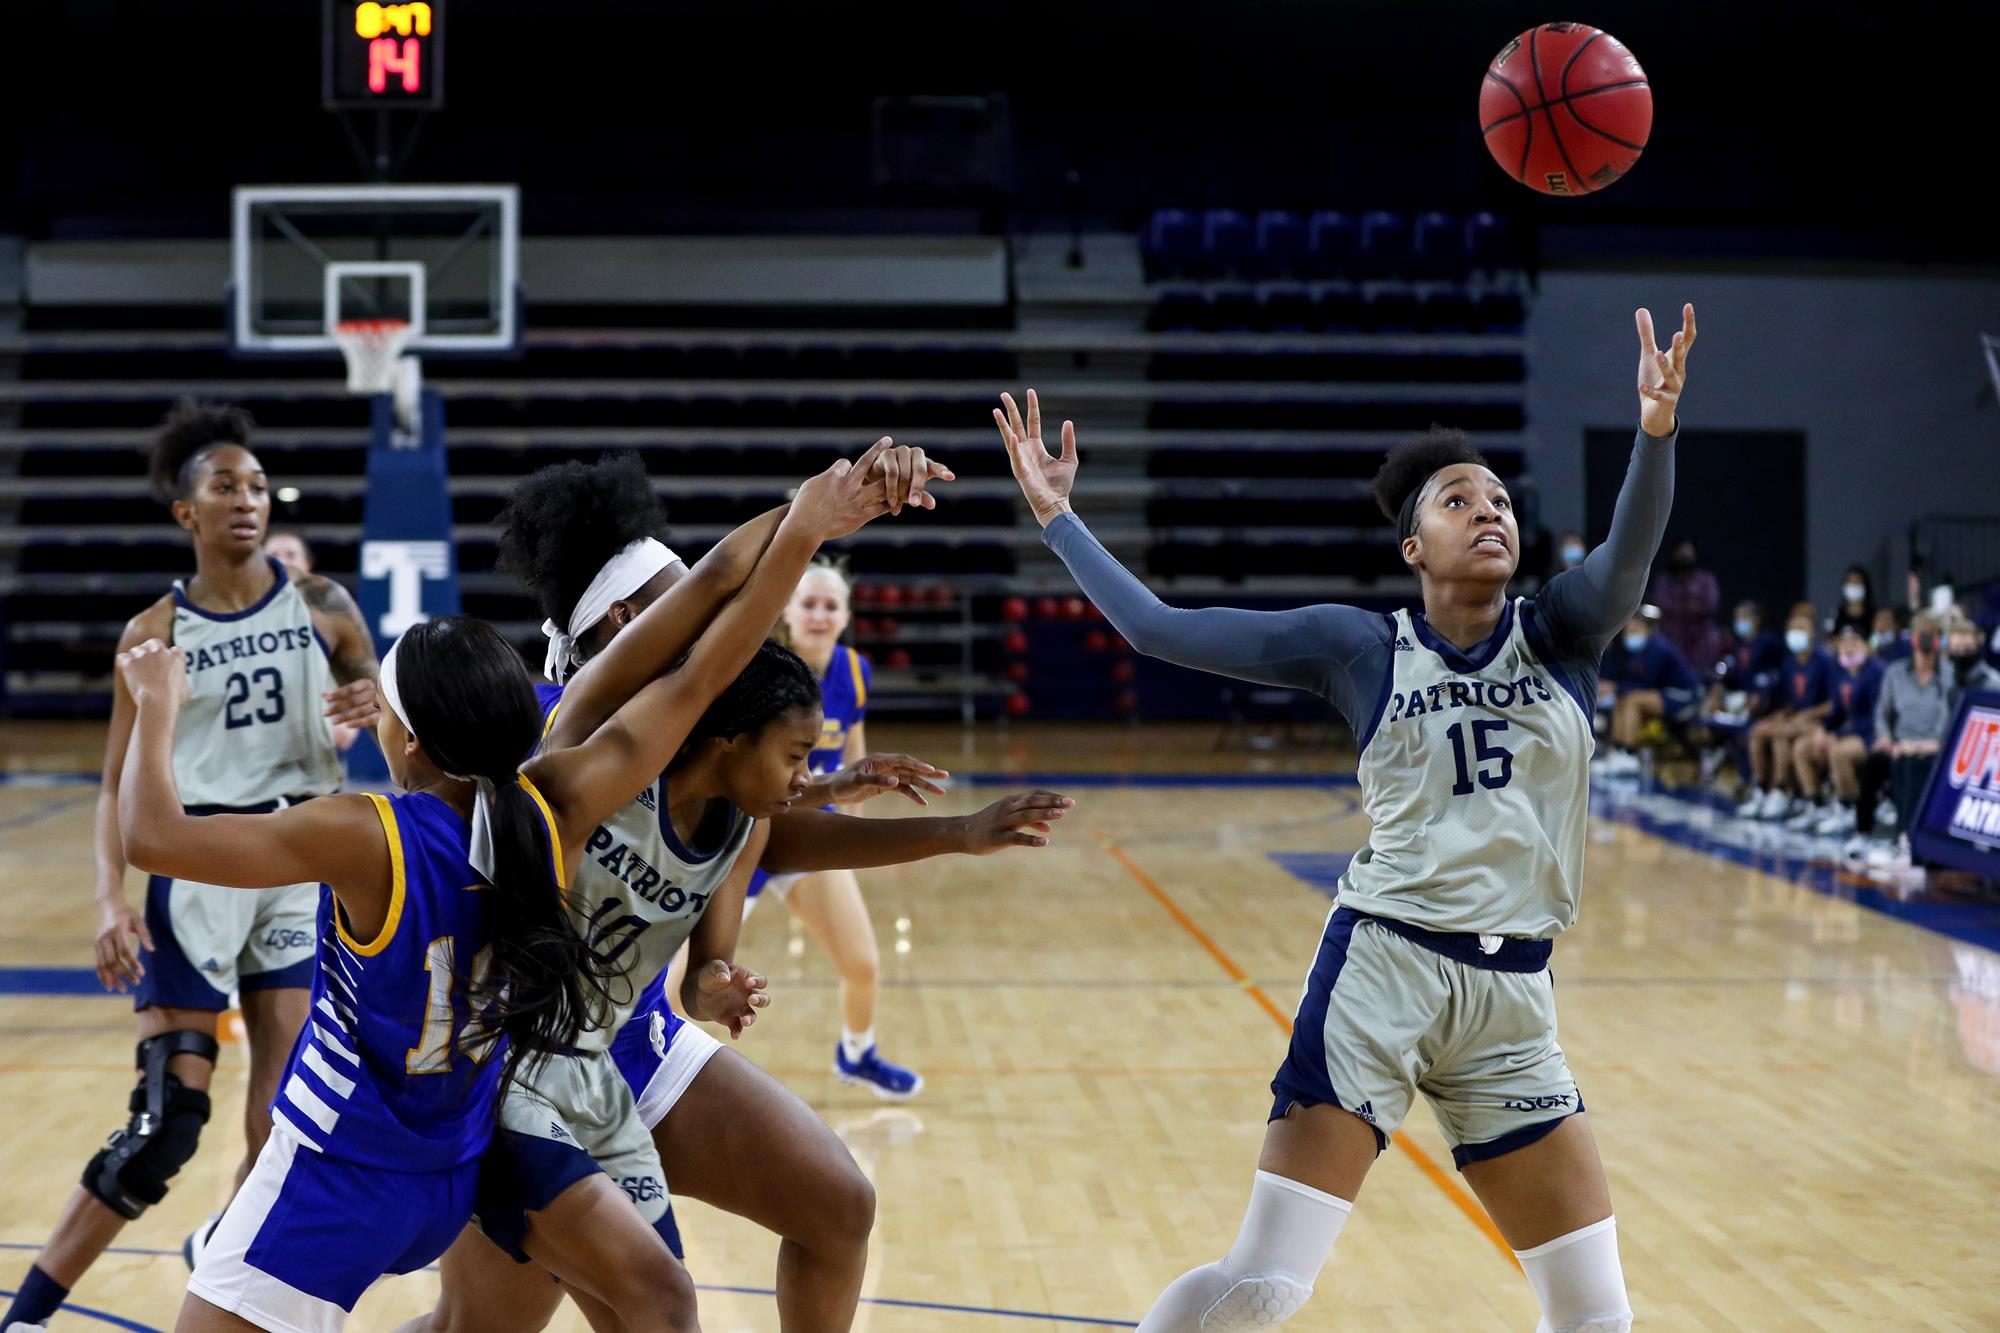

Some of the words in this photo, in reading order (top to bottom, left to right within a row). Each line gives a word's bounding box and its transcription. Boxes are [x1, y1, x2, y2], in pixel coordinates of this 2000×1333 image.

[368, 37, 420, 93] 14
[225, 666, 285, 729] 23
[1390, 676, 1552, 722] PATRIOTS
[1446, 719, 1514, 795] 15
